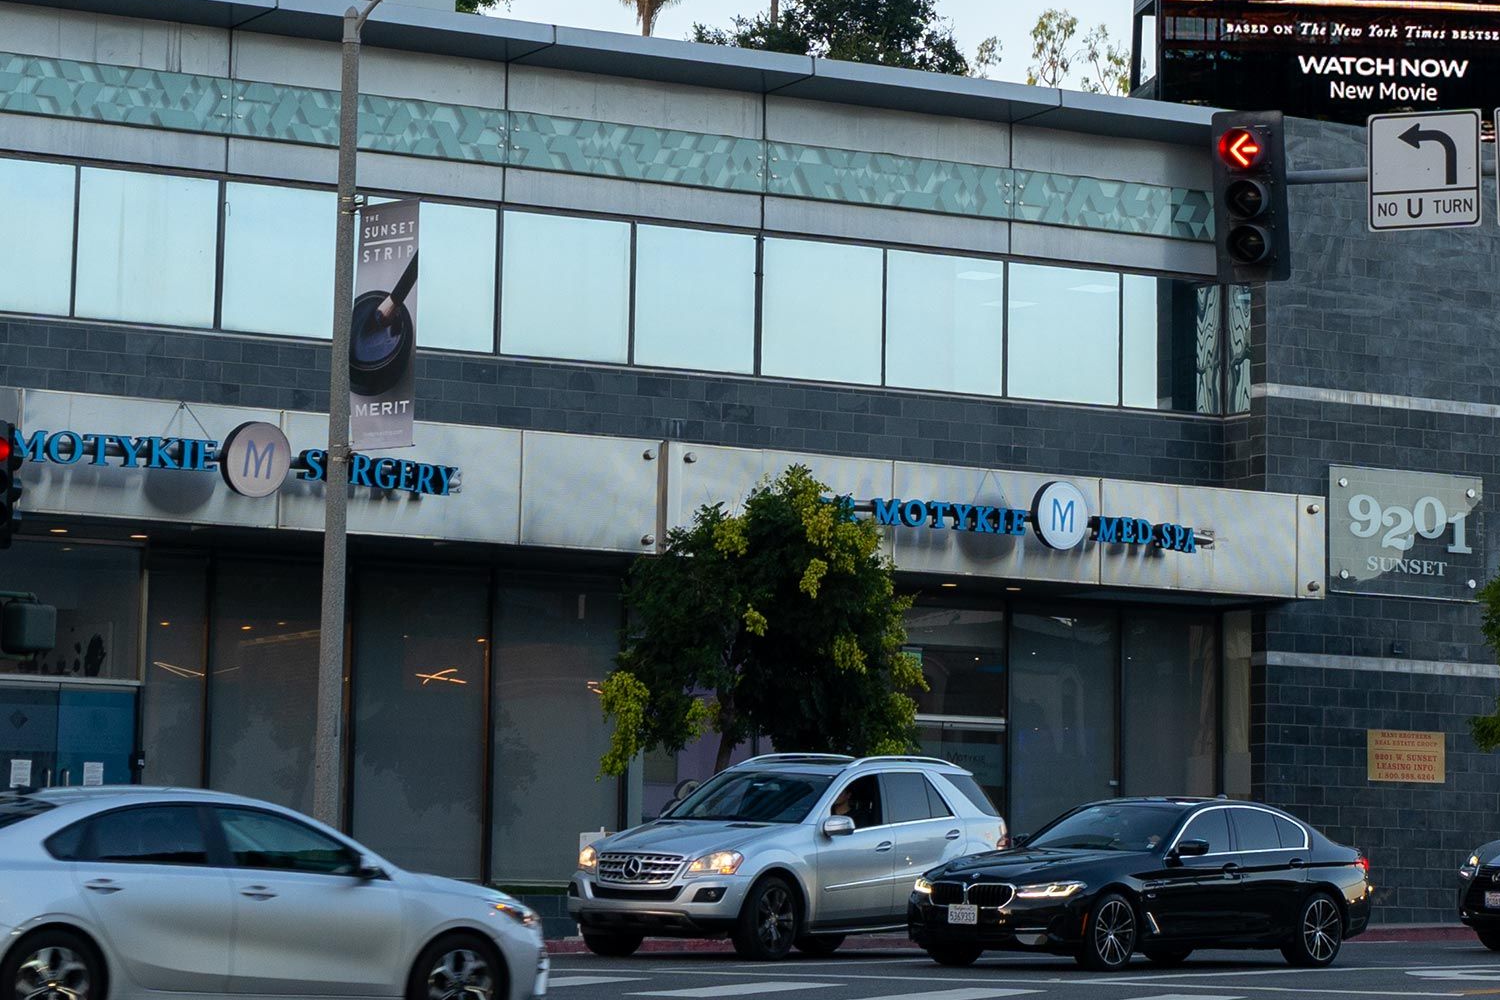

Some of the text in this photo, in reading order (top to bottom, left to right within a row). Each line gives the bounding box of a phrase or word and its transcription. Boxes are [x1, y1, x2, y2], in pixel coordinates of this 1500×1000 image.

[1226, 23, 1268, 34] BASED
[1273, 24, 1293, 35] ON
[1300, 22, 1326, 36] The
[1331, 23, 1362, 37] New
[1368, 25, 1398, 38] York
[1405, 26, 1446, 40] Times
[1298, 55, 1468, 78] WATCH NOW
[1330, 81, 1438, 101] New Movie
[1377, 197, 1473, 219] NO U TURN
[365, 214, 379, 223] THE
[364, 221, 414, 239] SUNSET
[363, 245, 413, 263] STRIP
[355, 400, 410, 417] MERIT
[14, 429, 218, 472] MOTYKIE
[304, 449, 459, 496] SRGERY
[873, 498, 1026, 536] MOTYKIE
[1096, 516, 1153, 544] MED
[1161, 523, 1197, 553] SPA
[1348, 494, 1472, 554] 9201
[1366, 556, 1447, 577] SUNSET
[1376, 763, 1411, 771] LEASING
[1407, 754, 1437, 762] SUNSET
